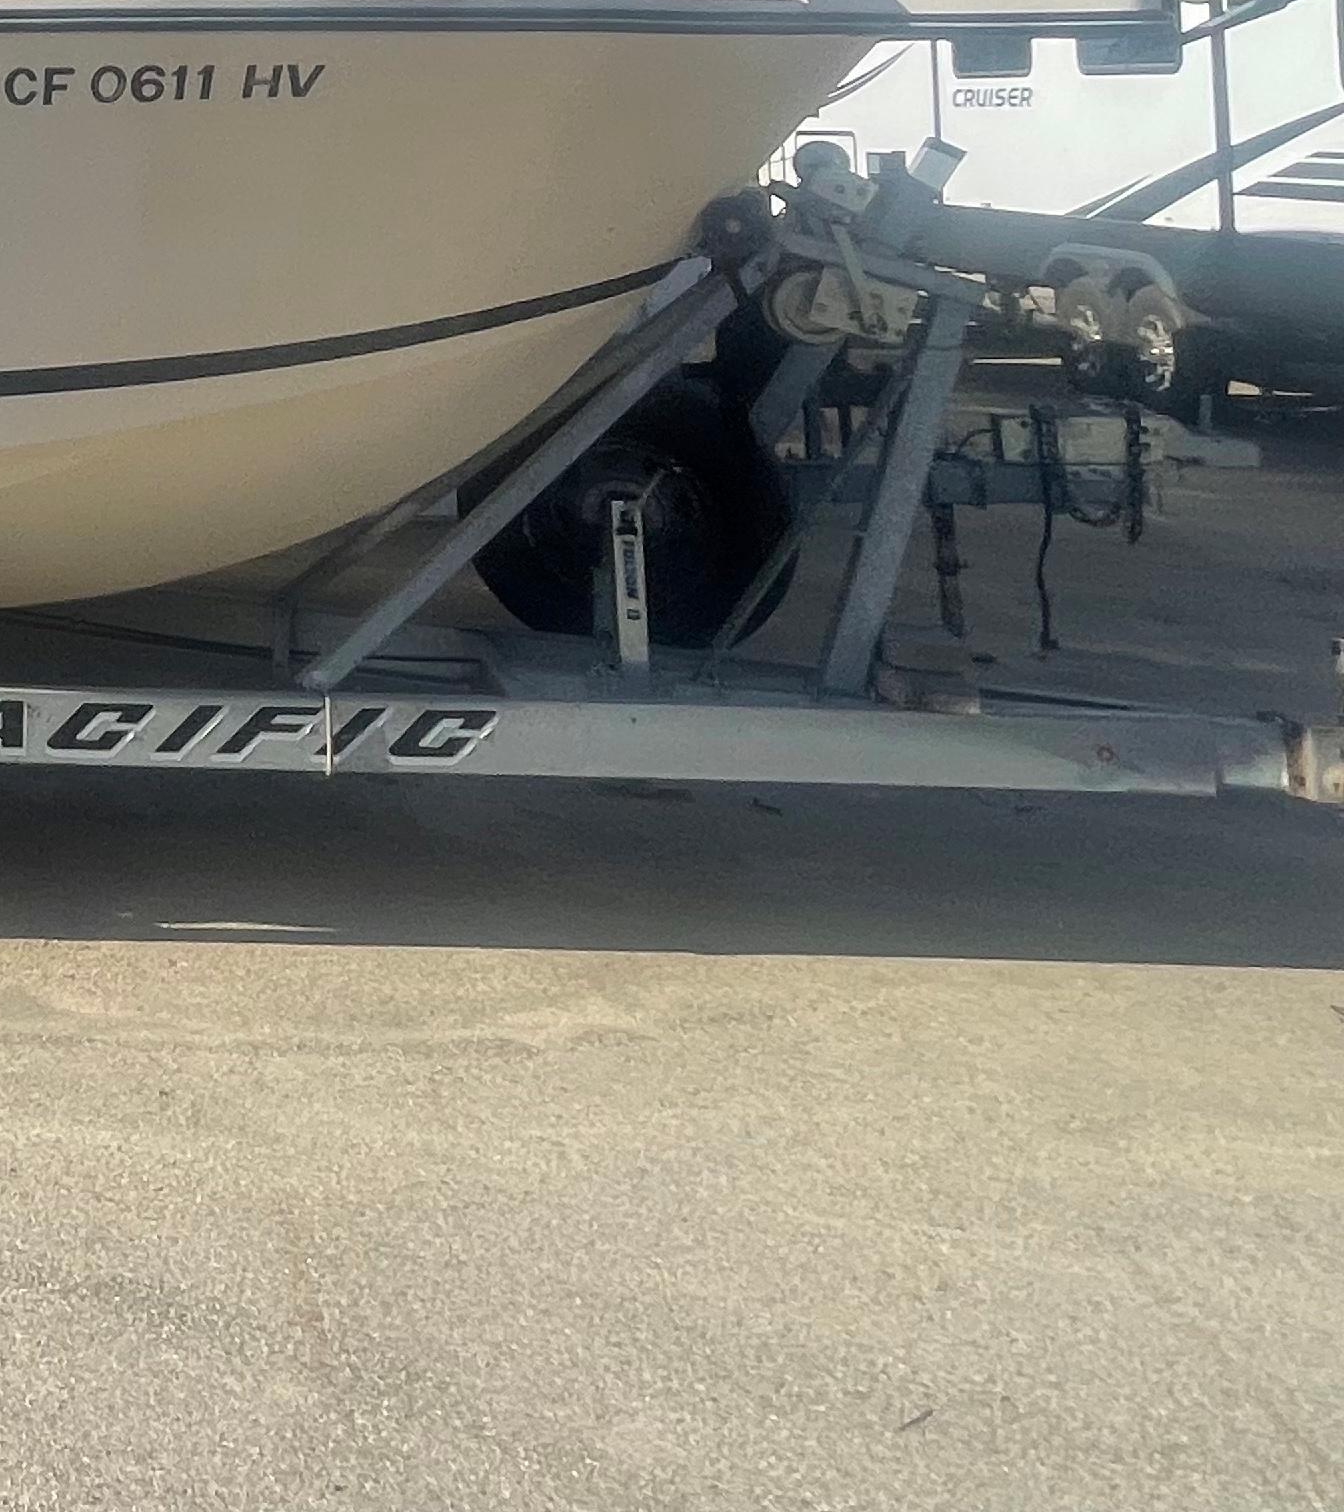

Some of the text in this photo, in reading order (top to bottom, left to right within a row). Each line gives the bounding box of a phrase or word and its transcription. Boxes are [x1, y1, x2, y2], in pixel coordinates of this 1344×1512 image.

[4, 66, 76, 106] CF
[242, 63, 326, 99] HV
[952, 87, 1033, 108] CRUISER
